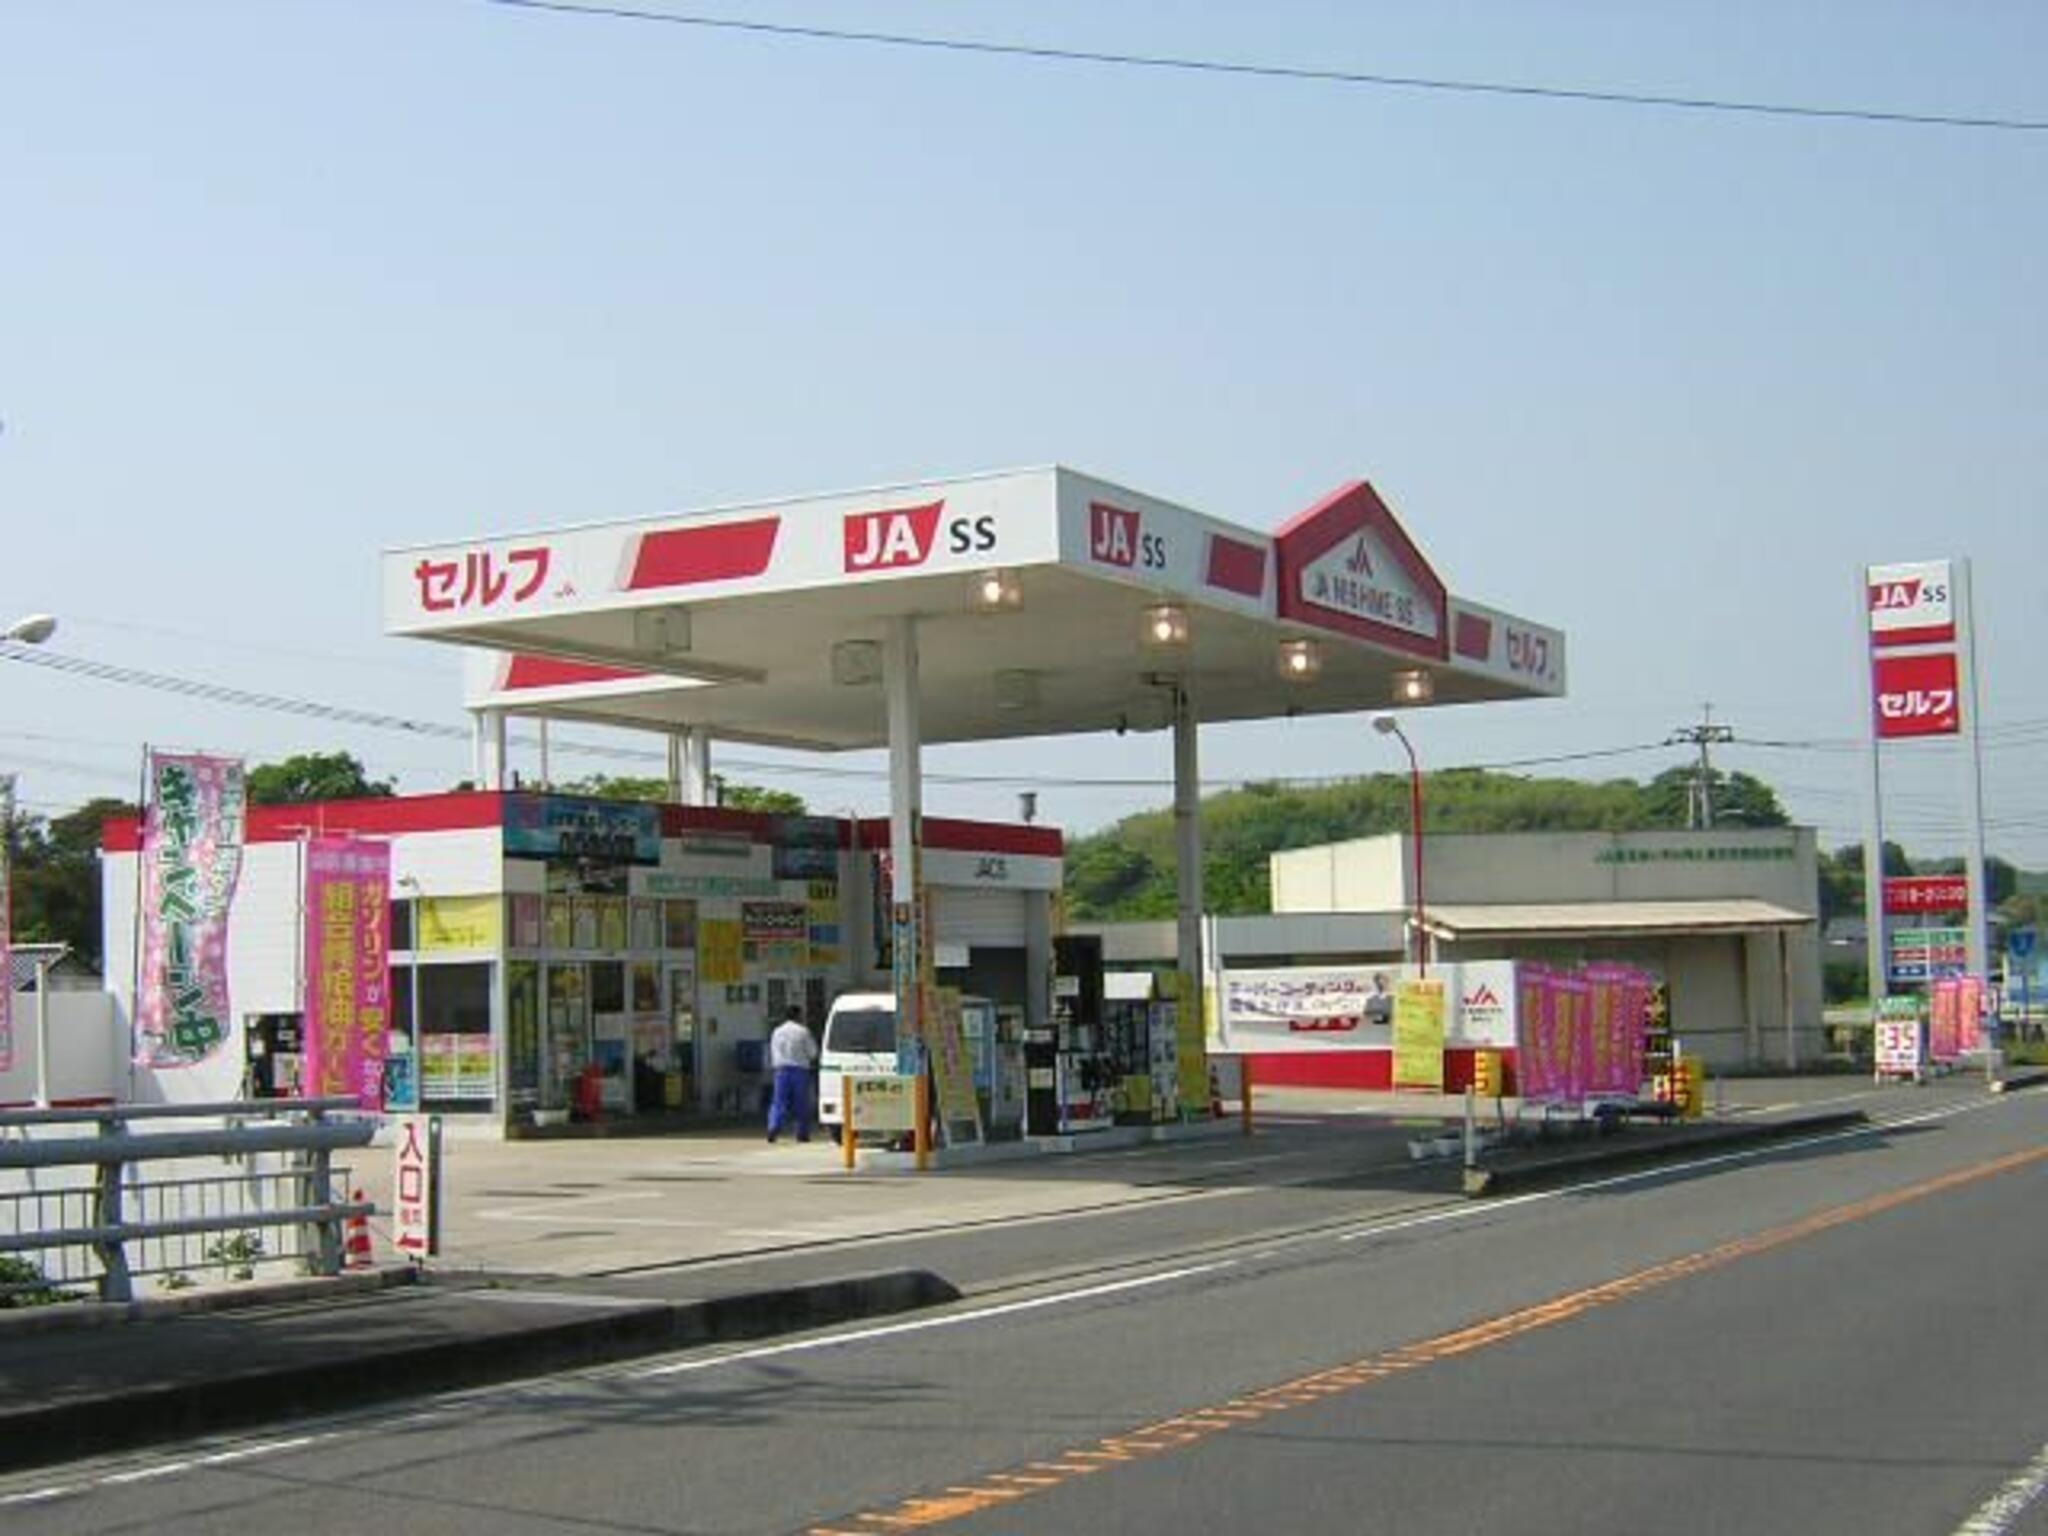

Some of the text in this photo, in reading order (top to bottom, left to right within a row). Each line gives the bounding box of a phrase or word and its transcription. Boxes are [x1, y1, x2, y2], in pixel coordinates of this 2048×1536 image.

[853, 513, 997, 566] JA SS
[1095, 510, 1166, 570] JA SS
[415, 547, 551, 612] セルフ
[1874, 583, 1947, 609] JA SS
[1506, 625, 1548, 676] セルフ
[1877, 689, 1954, 719] セルフ
[399, 1122, 423, 1203] 入口
